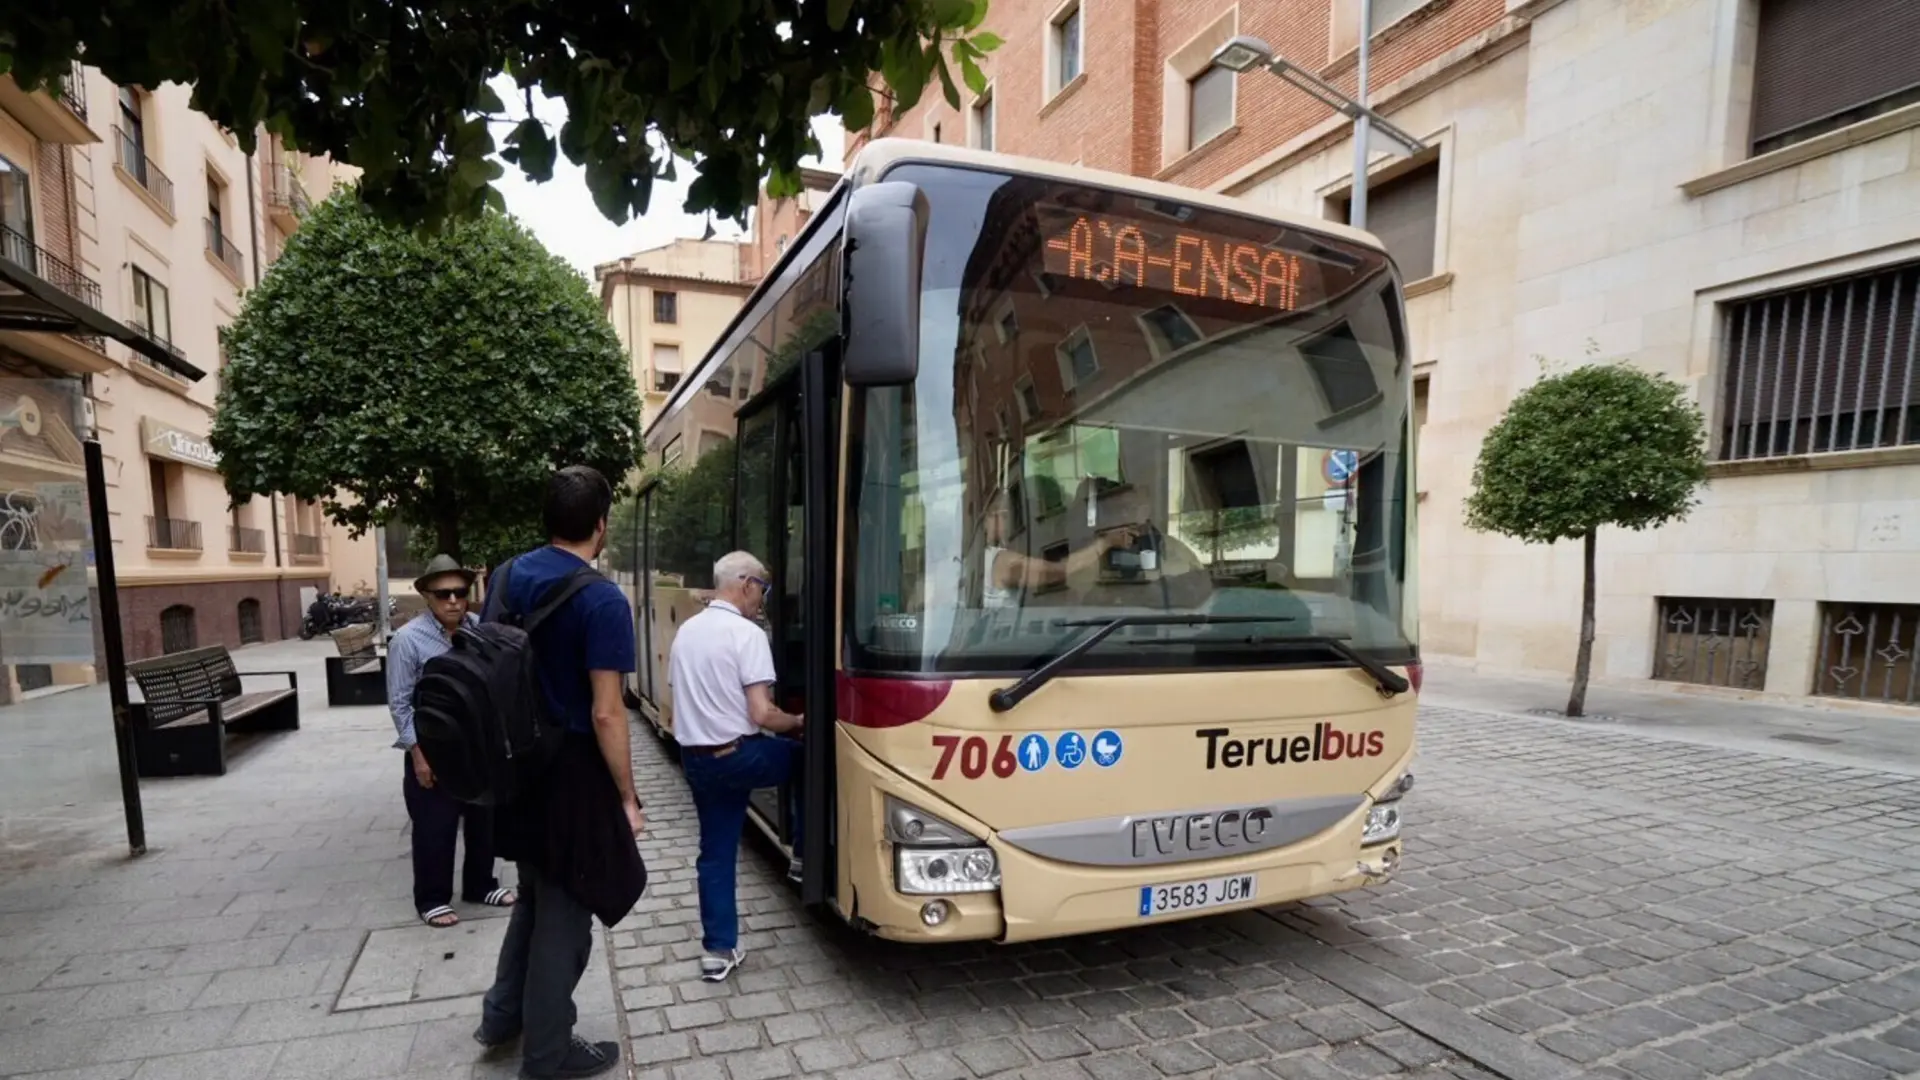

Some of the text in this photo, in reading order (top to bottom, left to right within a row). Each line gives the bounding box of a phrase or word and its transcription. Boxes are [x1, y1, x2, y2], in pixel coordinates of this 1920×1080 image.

[931, 735, 1017, 780] 706
[1195, 722, 1385, 770] Teruelbus
[1132, 807, 1273, 858] IVECO
[1156, 883, 1208, 911] 3583
[1215, 876, 1252, 902] JGW
